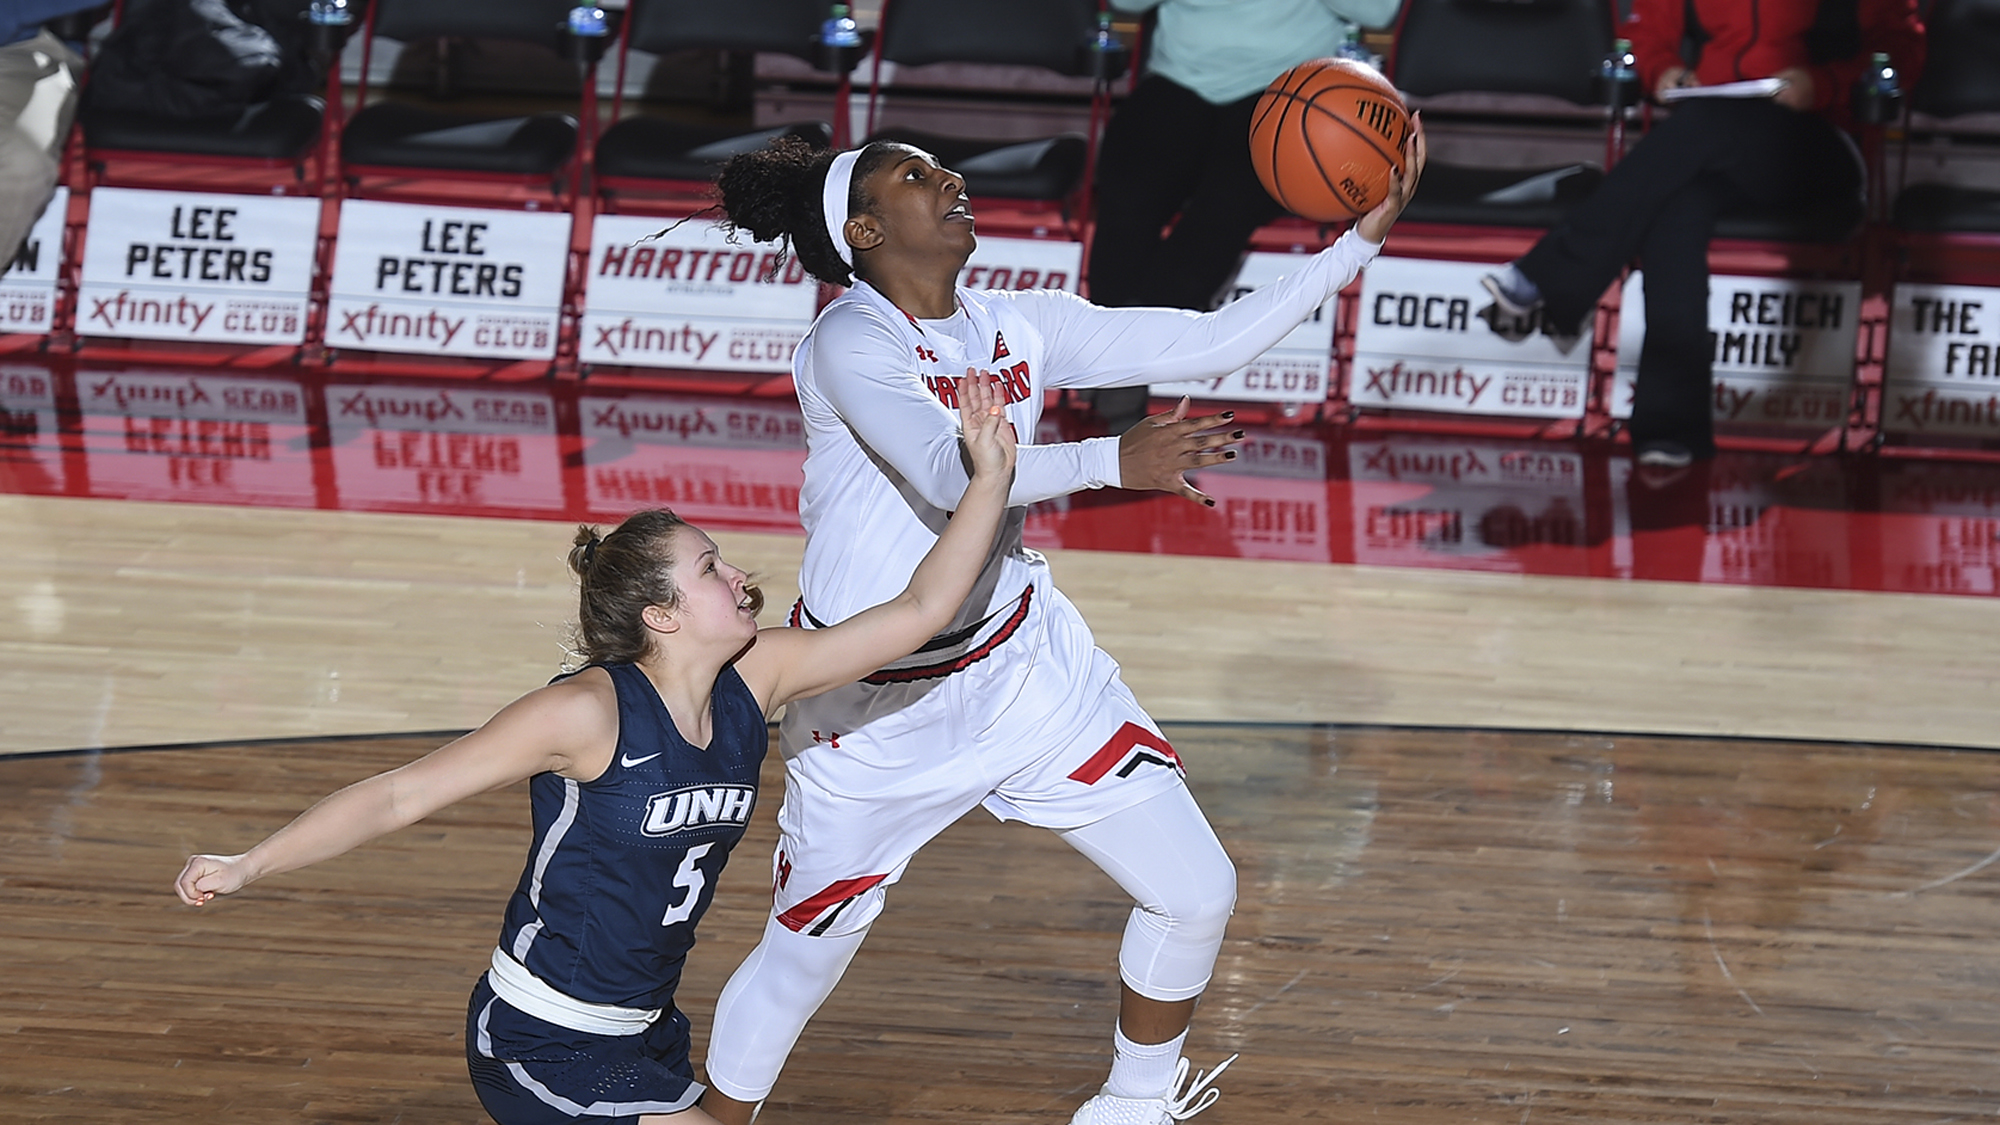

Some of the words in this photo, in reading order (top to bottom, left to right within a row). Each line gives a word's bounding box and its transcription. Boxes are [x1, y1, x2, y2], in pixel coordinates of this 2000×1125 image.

[1356, 99, 1397, 141] THE
[1340, 177, 1368, 209] ROCK
[171, 205, 237, 241] LEE
[421, 219, 488, 256] LEE
[126, 244, 273, 283] PETERS
[376, 257, 523, 298] PETERS
[599, 246, 806, 286] HARTFORD
[965, 266, 1067, 291] FORD
[90, 289, 213, 332] xfinity
[223, 313, 298, 334] CLUB
[340, 305, 465, 347] xfinity
[475, 328, 549, 349] CLUB
[1731, 292, 1842, 328] REICH
[1911, 298, 1983, 334] THE
[594, 319, 719, 361] xfinity
[1711, 331, 1802, 367] MILY
[1945, 343, 2000, 377] FA
[1245, 371, 1320, 391] CLUB
[1364, 361, 1493, 405] xfinity
[1502, 385, 1578, 408] CLUB
[644, 786, 754, 834] UNH
[661, 841, 716, 927] 5
